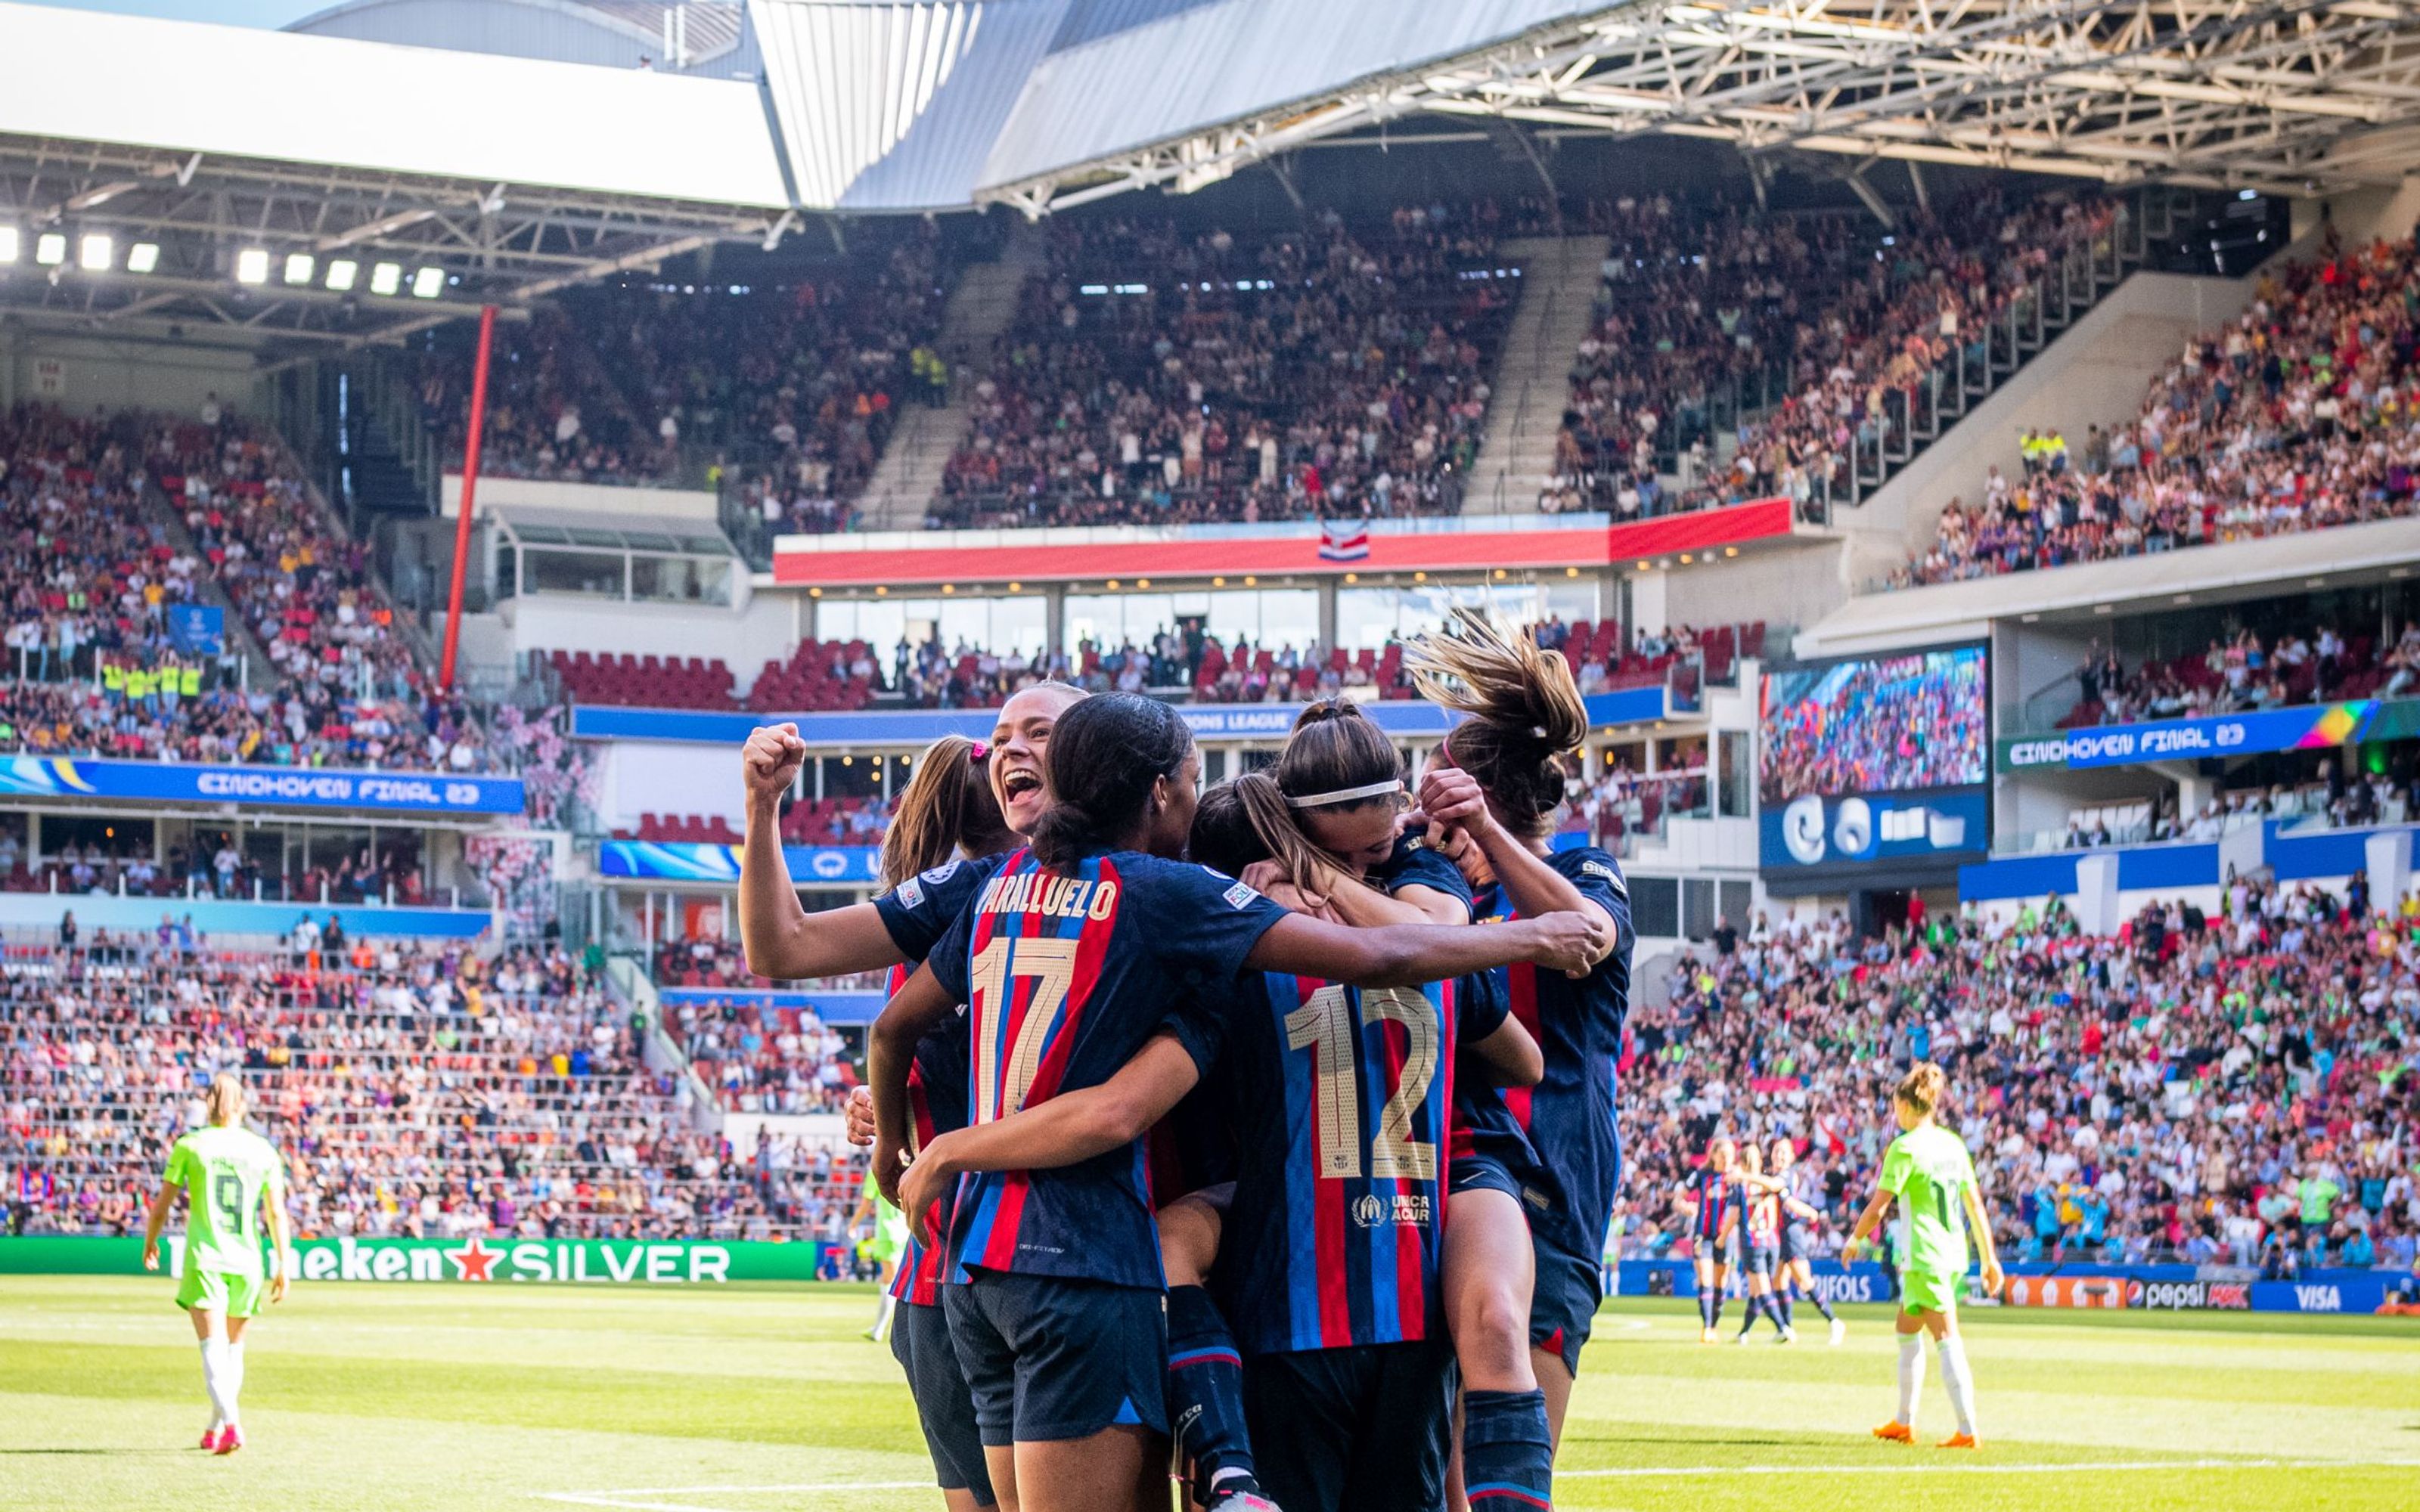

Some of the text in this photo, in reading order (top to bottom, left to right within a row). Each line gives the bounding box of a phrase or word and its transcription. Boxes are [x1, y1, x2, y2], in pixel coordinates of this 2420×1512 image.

[1227, 712, 1289, 730] LEAGUE
[2010, 723, 2246, 766] EINDHOVEN FINAL 23
[197, 772, 480, 805] EINDHOVEN FINAL 23
[975, 873, 1117, 921] PARALLUELO
[972, 937, 1080, 1125] 17
[1284, 984, 1438, 1180] 12
[216, 1175, 244, 1235] 9
[510, 1244, 731, 1283] SILVER
[1798, 1275, 1872, 1302] RIFOLS
[2146, 1281, 2205, 1311] pepsi
[2294, 1284, 2341, 1310] VISA
